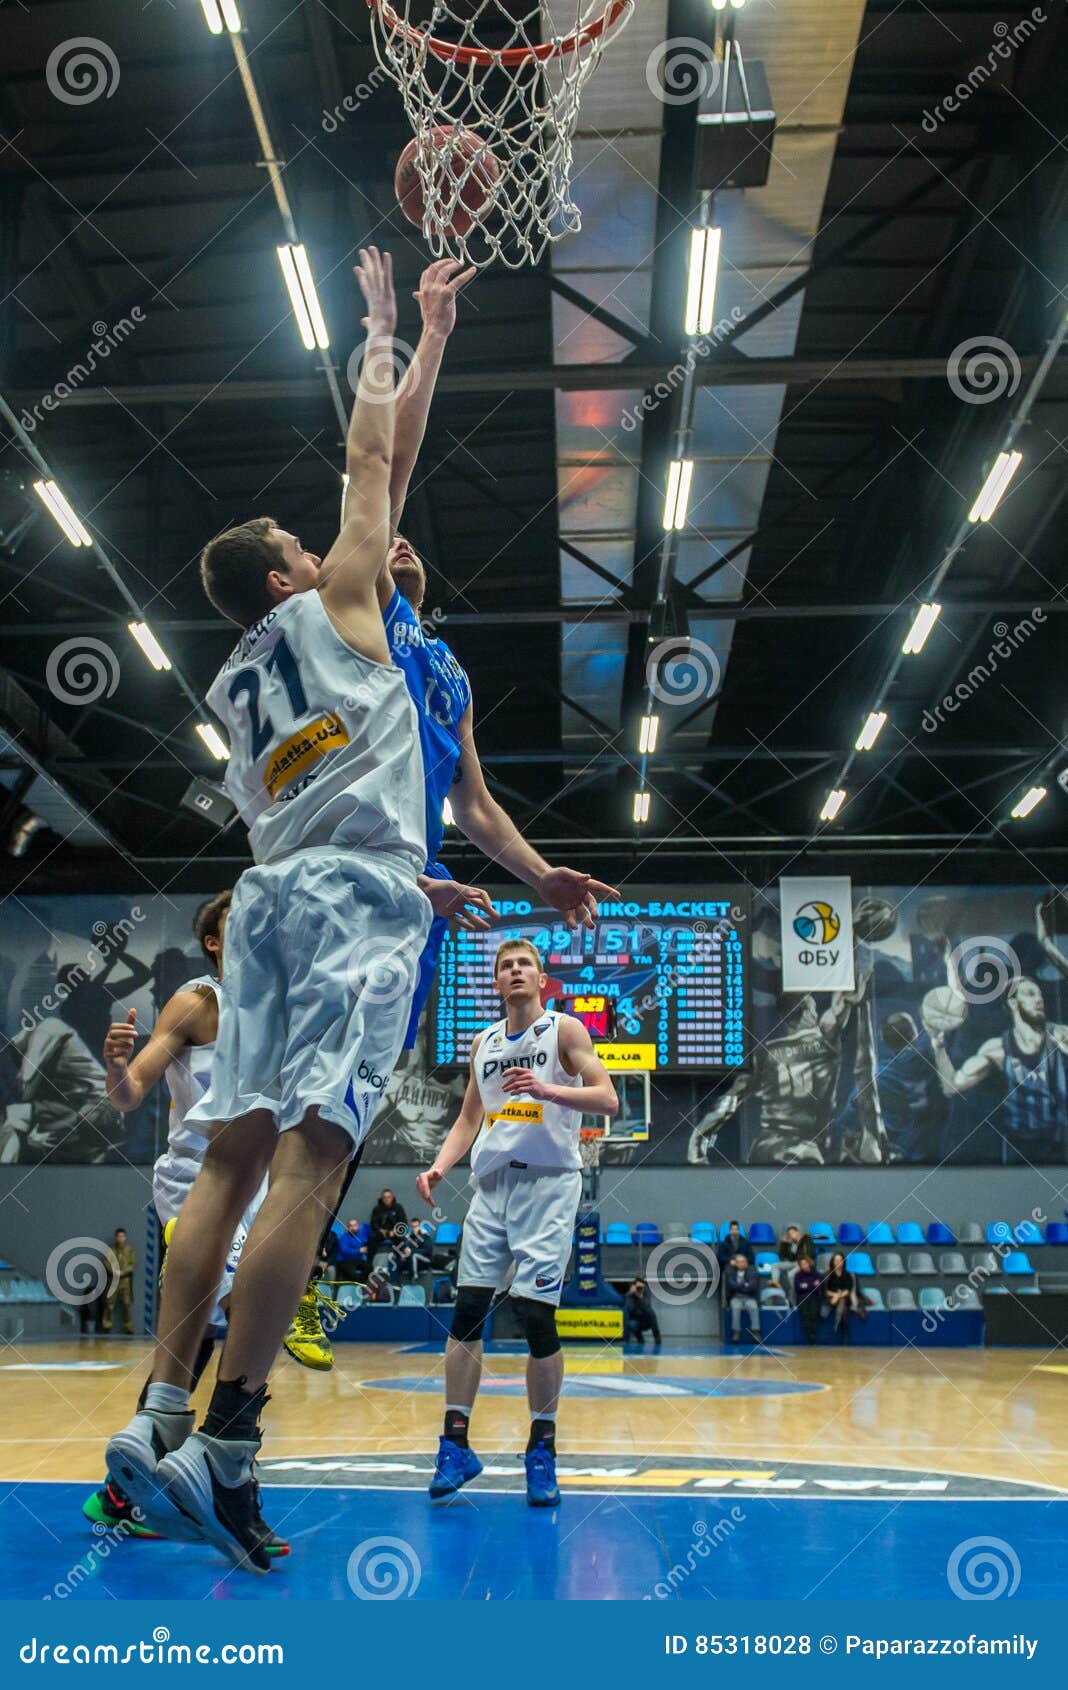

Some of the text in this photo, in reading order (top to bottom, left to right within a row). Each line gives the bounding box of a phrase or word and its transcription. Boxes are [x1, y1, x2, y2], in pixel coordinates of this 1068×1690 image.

[228, 636, 309, 763] 21
[532, 930, 572, 951] 49
[605, 930, 639, 951] 51
[725, 942, 742, 951] 10
[660, 953, 669, 962] 7
[726, 953, 742, 962] 11
[798, 949, 840, 966] ФБУ
[579, 966, 595, 981] 4
[655, 964, 672, 974] 10
[439, 975, 455, 985] 17
[561, 984, 620, 996] ПЕРІОД
[726, 998, 743, 1008] 17
[437, 1008, 455, 1019] 22
